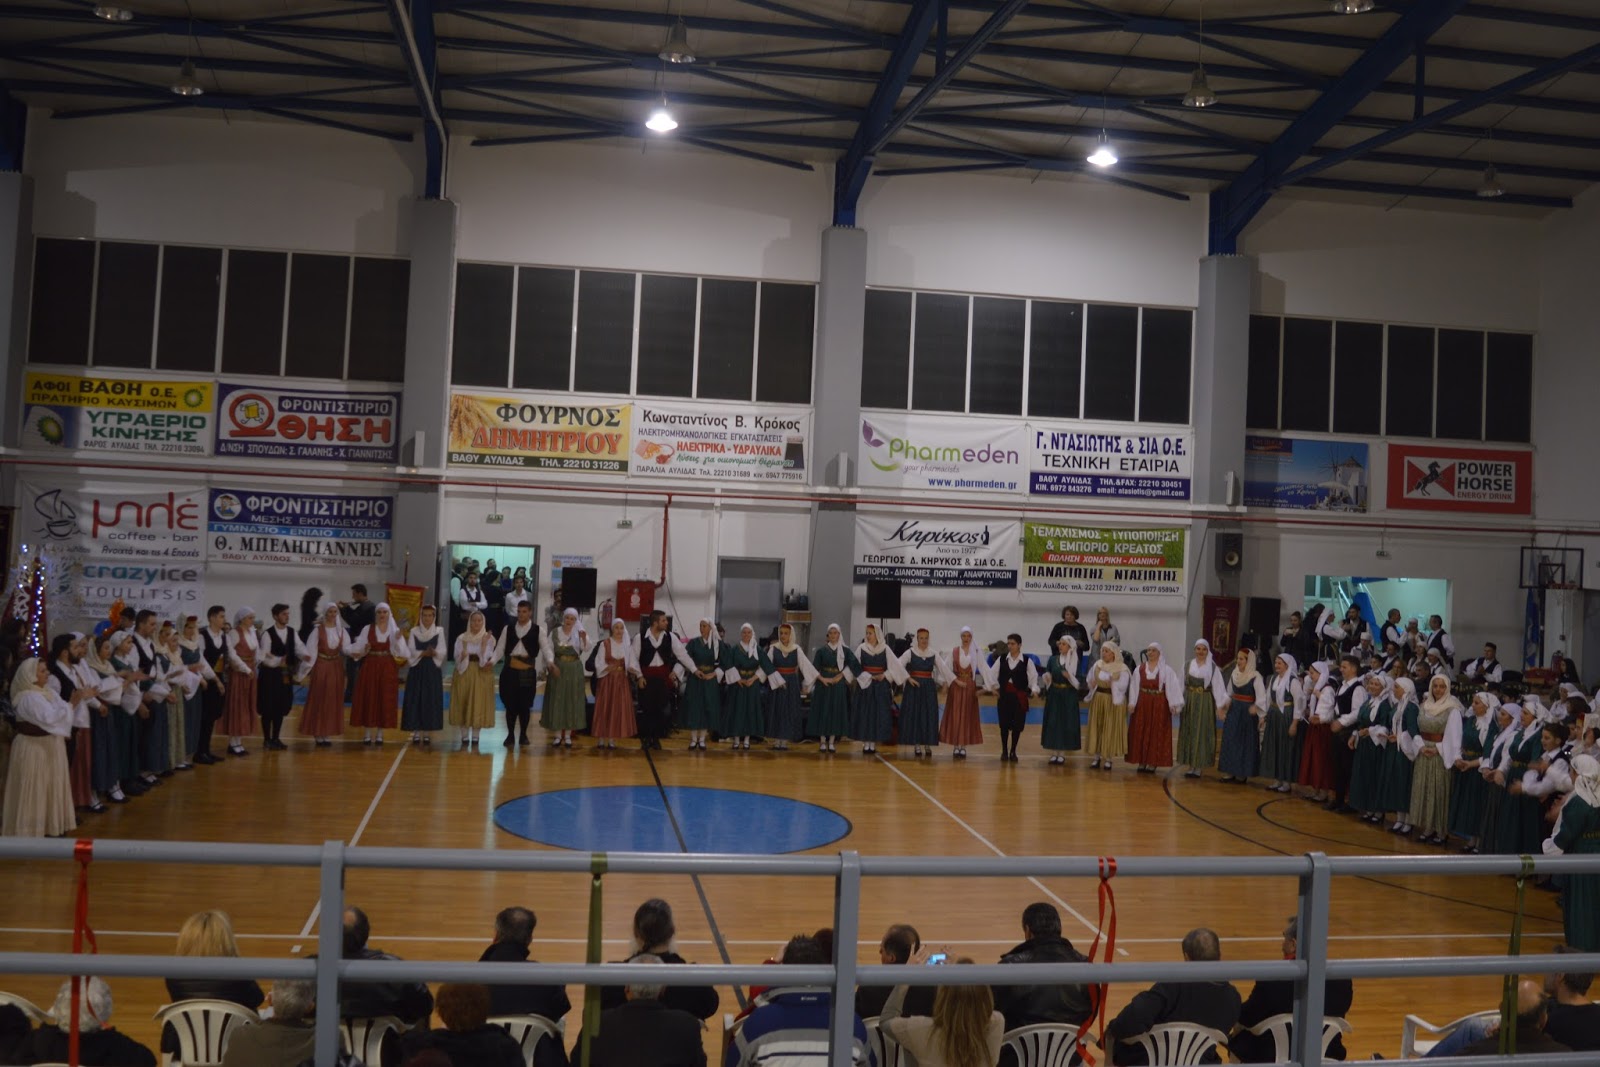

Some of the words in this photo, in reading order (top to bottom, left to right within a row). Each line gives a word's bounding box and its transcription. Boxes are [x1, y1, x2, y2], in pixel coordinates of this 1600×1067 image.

[33, 380, 70, 393] ΑΦΟΙ
[80, 380, 142, 396] ΒΑΘΗ
[151, 387, 177, 398] Ο.Ε.
[32, 393, 100, 405] ΠΡΑΤΗΡΙΟ
[107, 398, 177, 409] ΚΑΥΣΙΜΩΝ
[281, 399, 389, 414] ΦΡΟΝΤΙΣΤΗΡΙΟ
[87, 410, 207, 429] ΥΓΡΑΕΡΙΟ
[496, 402, 621, 427] ΦΟΥΡΝΟΣ
[643, 410, 728, 429] Κωνσταντίνος
[735, 415, 747, 427] Β.
[754, 416, 801, 432] Κρόκος
[92, 427, 198, 443] ΚΙΝΗΣΗΣ
[471, 427, 623, 454] ΔΗΜΗΤΡΙΟΥ
[638, 428, 727, 440] ΗΛΕΚΤΡΟΜΗΧΑΝΟΛΟΓΙΚΕΣ
[730, 433, 782, 442] ΕΓΚΑΤΑΣΤΑΣΕΙΣ
[83, 440, 107, 449] ΦΑΡΟΣ
[111, 441, 140, 451] ΑΥΛΙΔΑΣ
[676, 441, 725, 453] ΗΛΕΚΤΡΙΚΑ
[733, 444, 782, 455] ΥΔΡΑΥΛΙΚΑ
[1036, 431, 1047, 449] Γ.
[1050, 432, 1121, 453] ΝΤΑΣΙΩΤΗΣ
[1125, 438, 1134, 454] &
[1138, 437, 1158, 454] ΣΙΑ
[1162, 438, 1186, 456] Ο.Ε.
[298, 446, 333, 456] ΓΑΛΑΝΗΣ
[349, 448, 393, 459] ΓΙΑΝΝΙΤΣΗΣ
[452, 453, 479, 462] ΒΑΘΥ
[484, 456, 525, 465] ΑΥΛΙΔΑΣ
[540, 458, 561, 467] ΤΗΛ.
[563, 459, 590, 469] 22210
[592, 461, 620, 470] 31226
[903, 463, 918, 473] your
[1042, 453, 1109, 469] ΤΕΧΝΙΚΗ
[1120, 457, 1179, 472] ΕΤΑΙΡΙΑ
[635, 465, 665, 473] ΠΑΡΑΛΙΑ
[714, 468, 731, 476] 22210
[766, 472, 782, 480] 6947
[1457, 462, 1512, 477] POWER
[928, 477, 1017, 490] www.pharmeden.gr
[1038, 475, 1057, 483] ΒΑΘΥ
[1061, 476, 1092, 485] ΑΥΛΙΔΑΣ
[1138, 479, 1159, 487] 22210
[1457, 477, 1512, 491] HORSE
[1457, 491, 1486, 499] ENERGY
[246, 495, 388, 517] ΦΡΟΝΤΙΣΤΗΡΙΟ
[251, 514, 292, 524] ΜΕΣΗΣ
[299, 517, 381, 527] ΕΚΠΑΙΔΕΥΣΗΣ
[108, 531, 156, 542] coffee
[172, 533, 198, 542] bar
[213, 523, 278, 534] ΓΥΜΝΑΣΙΟ
[290, 527, 333, 537] ΕΝΙΑΙΟ
[339, 529, 386, 539] ΛΥΚΕΙΟ
[882, 520, 978, 550] Κηρύκος
[1032, 526, 1099, 539] ΤΕΜΑΧΙΣΜΟΣ
[1112, 530, 1178, 541] ΤΥΠΟΠΟΙΗΣΗ
[214, 535, 233, 550] Θ.
[240, 536, 383, 557] ΜΠΕΛΗΓΙΑΝΝΗΣ
[1046, 540, 1055, 550] &
[1060, 541, 1108, 552] ΕΜΠΟΡΙΟ
[1114, 543, 1163, 553] ΚΡΕΑΤΟΣ
[221, 553, 247, 561] ΒΑΘΥ
[863, 554, 905, 564] ΓΕΩΡΓΙΟΣ
[909, 557, 919, 565] Δ.
[921, 556, 962, 566] ΚΗΡΥΚΟΣ
[965, 558, 971, 566] &
[974, 558, 987, 566] ΣΙΑ
[989, 559, 1006, 567] Ο.Ε.
[1048, 553, 1079, 561] ΠΩΛΗΣΗ
[1083, 555, 1121, 564] ΧΟΝΔΡΙΚΗ
[1128, 557, 1159, 565] ΛΙΑΝΙΚΗ
[83, 562, 197, 584] crazyice
[856, 566, 889, 575] ΕΜΠΟΡΙΟ
[895, 568, 931, 576] ΔΙΑΝΟΜΕΣ
[963, 571, 1012, 579] ΑΝΑΨΥΚΤΙΚΩΝ
[1027, 565, 1103, 579] ΠΑΝΑΓΙΩΤΗΣ
[1114, 569, 1177, 581] ΝΤΑΣΙΩΤΗΣ
[85, 586, 197, 601] TOULITSIS
[1042, 582, 1067, 590] Αυλίδας
